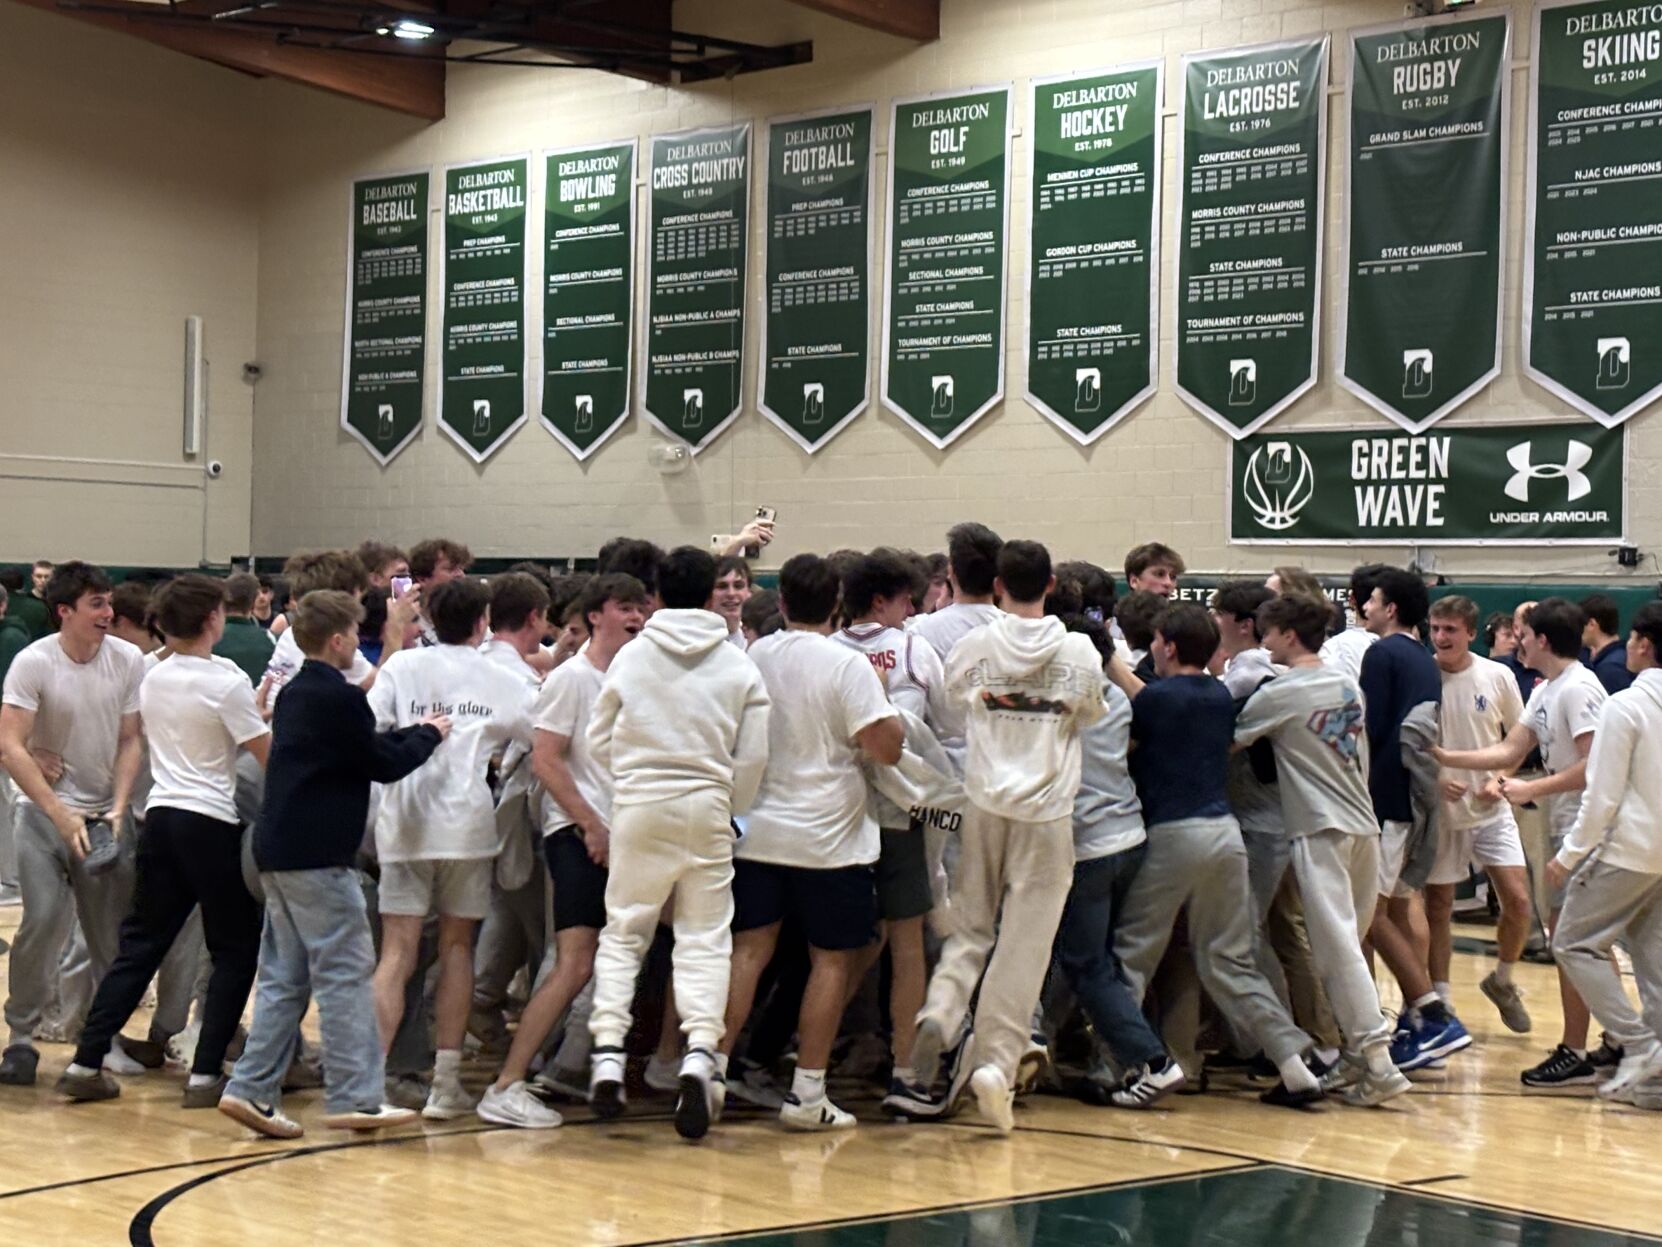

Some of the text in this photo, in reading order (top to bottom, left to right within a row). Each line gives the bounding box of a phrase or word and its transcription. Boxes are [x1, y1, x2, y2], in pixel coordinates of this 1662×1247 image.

[1566, 4, 1662, 36] DELBARTO
[1377, 31, 1480, 63] DELBARTON
[1583, 29, 1660, 69] SKIING
[1206, 58, 1300, 87] DELBARTON
[1393, 58, 1462, 95] RUGBY
[1594, 68, 1647, 85] EST. 2014
[1053, 81, 1138, 109] DELBARTON
[1204, 81, 1301, 120] LACROSSE
[1402, 94, 1449, 110] EST. 2012
[912, 102, 990, 128] DELBARTON
[1558, 99, 1662, 121] CONFERENCE CHAMPI
[1061, 104, 1128, 139] HOCKEY
[1230, 121, 1248, 132] EST.
[785, 122, 855, 146] DELBARTON
[930, 126, 969, 155] GOLF
[1369, 121, 1484, 144] GRAND SLAM CHAMPIONS
[667, 139, 733, 162] DELBARTON
[1074, 141, 1092, 151] EST.
[1199, 143, 1301, 164] CONFERENCE CHAMPIONS
[559, 155, 619, 176] DELBARTON
[783, 142, 855, 175] FOOTBALL
[931, 159, 946, 169] EST.
[458, 168, 515, 189] DELBARTON
[653, 155, 745, 190] CROSS COUNTRY
[1080, 168, 1095, 178] CUP
[1095, 162, 1138, 176] CHAMPIONS
[1575, 161, 1662, 181] NJAC CHAMPIONS
[365, 182, 418, 201] DELBARTON
[560, 174, 616, 202] BOWLING
[907, 180, 989, 198] CONFERENCE CHAMPIONS
[448, 185, 524, 216] BASKETBALL
[791, 197, 844, 211] PREP CHAMPIONS
[1192, 199, 1305, 219] MORRIS COUNTY CHAMPIONS
[363, 199, 417, 225] BASEBALL
[662, 209, 733, 225] CONFERENCE CHAMPIONS
[556, 223, 620, 238] CONFERENCE CHAMPIONS
[901, 231, 994, 248] MORRIS COUNTY CHAMPIONS
[1556, 224, 1662, 243] NON-PUBLIC CHAMPIO
[1046, 240, 1137, 257] GORDON CUP CHAMPIONS
[1381, 242, 1463, 259] STATE CHAMPIONS
[571, 271, 592, 280] COUNTY
[592, 267, 623, 278] CHAMPIONS
[778, 266, 854, 282] CONFERENCE CHAMPIONS
[909, 266, 984, 281] SECTIONAL CHAMPIONS
[1210, 257, 1283, 273] STATE CHAMPIONS
[679, 272, 702, 281] COUNTY
[703, 268, 738, 279] CHAMPIONS
[454, 281, 485, 291] CONFERENCE
[1570, 286, 1661, 303] STATE CHAMPIONS
[715, 308, 741, 318] CHAMPS
[915, 300, 974, 313] STATE CHAMPIONS
[585, 313, 615, 323] CHAMPIONS
[1187, 312, 1304, 329] TOURNAMENT OF CHAMPIONS
[898, 333, 992, 347] TOURNAMENT OF CHAMPIONS
[1057, 324, 1122, 338] STATE CHAMPIONS
[787, 344, 842, 355] STATE CHAMPIONS
[561, 358, 608, 370] STATE CHAMPIONS
[1351, 436, 1451, 480] GREEN
[1354, 484, 1445, 527] WAVE
[1490, 510, 1607, 524] UNDER ARMOUR
